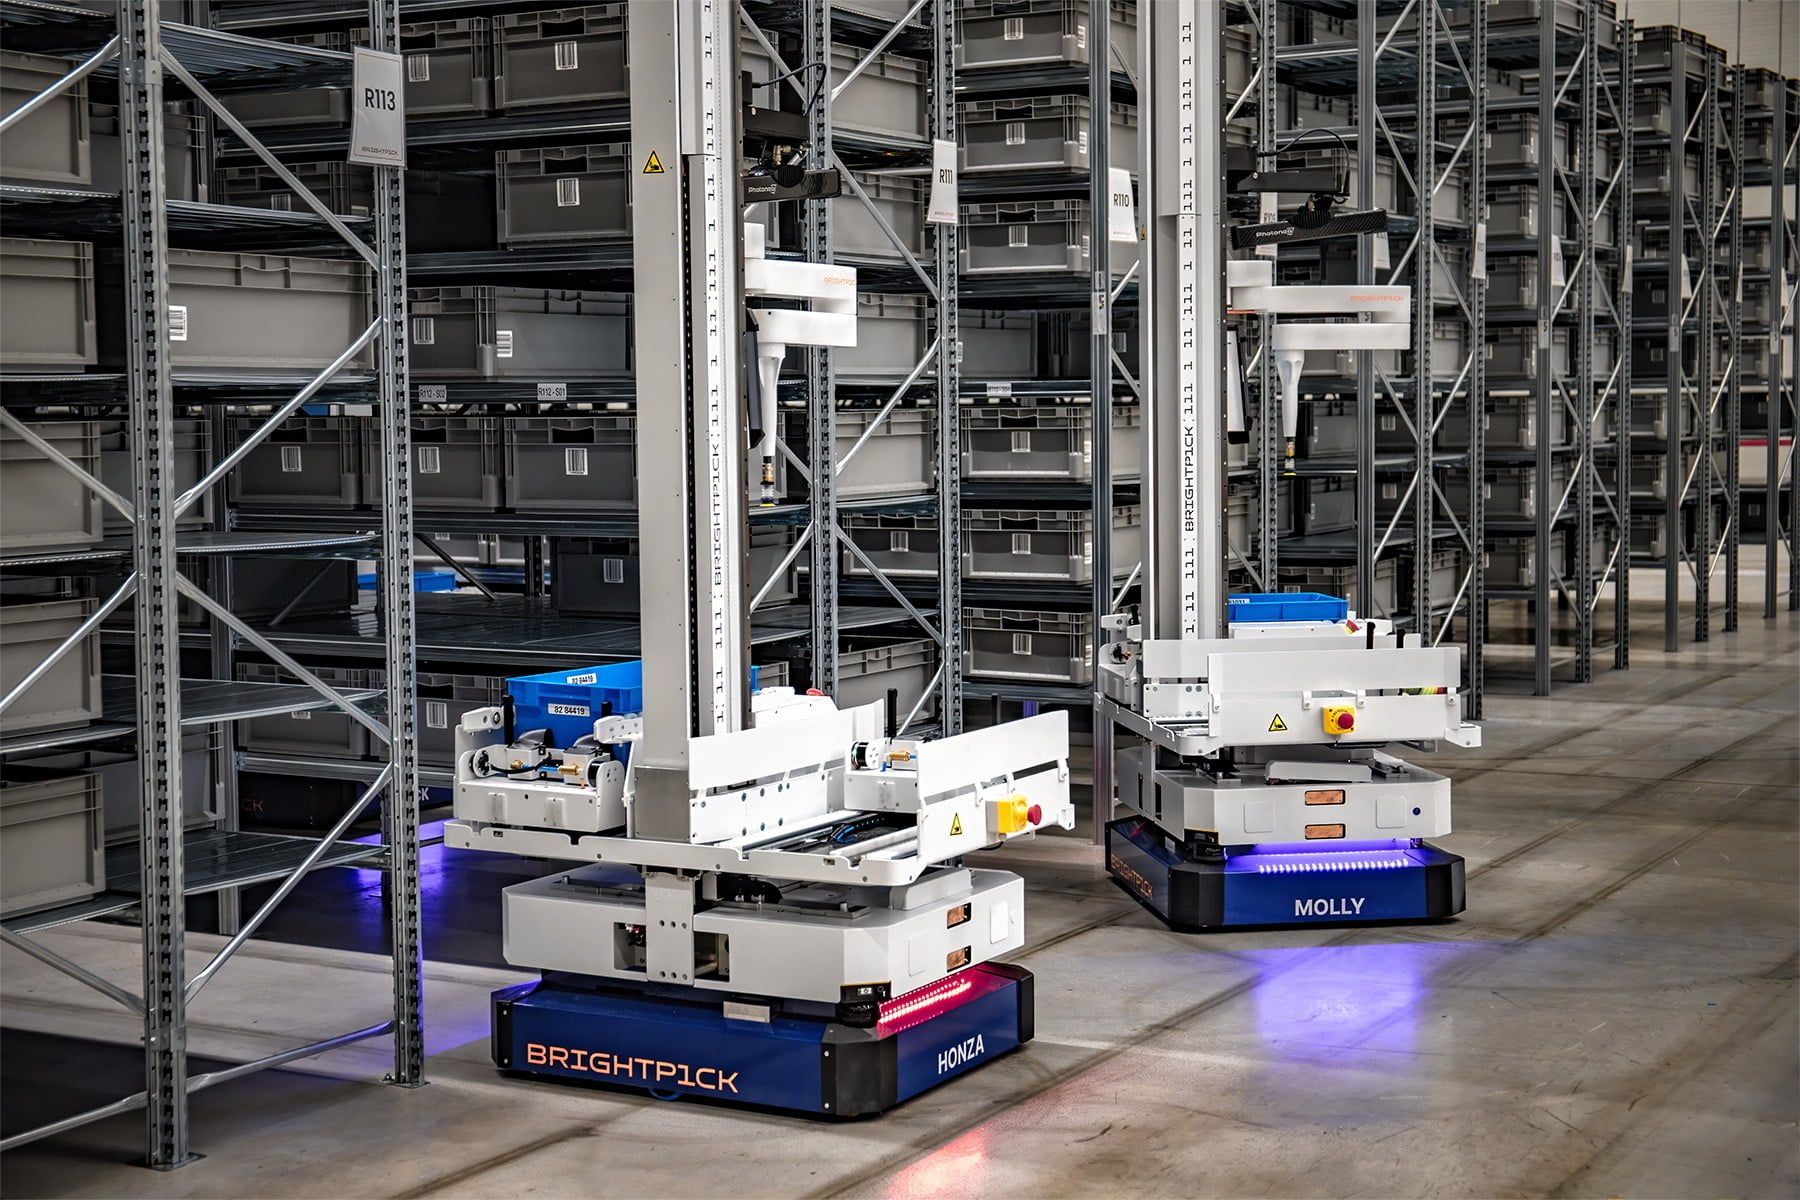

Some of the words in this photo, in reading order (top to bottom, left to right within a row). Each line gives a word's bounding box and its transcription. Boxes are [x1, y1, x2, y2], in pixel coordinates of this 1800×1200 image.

[364, 87, 396, 111] R113
[939, 168, 953, 185] R111
[1113, 193, 1130, 208] R110
[553, 705, 563, 713] 82
[564, 706, 585, 715] 84419
[1295, 898, 1366, 917] MOLLY
[938, 1033, 985, 1075] HONZA
